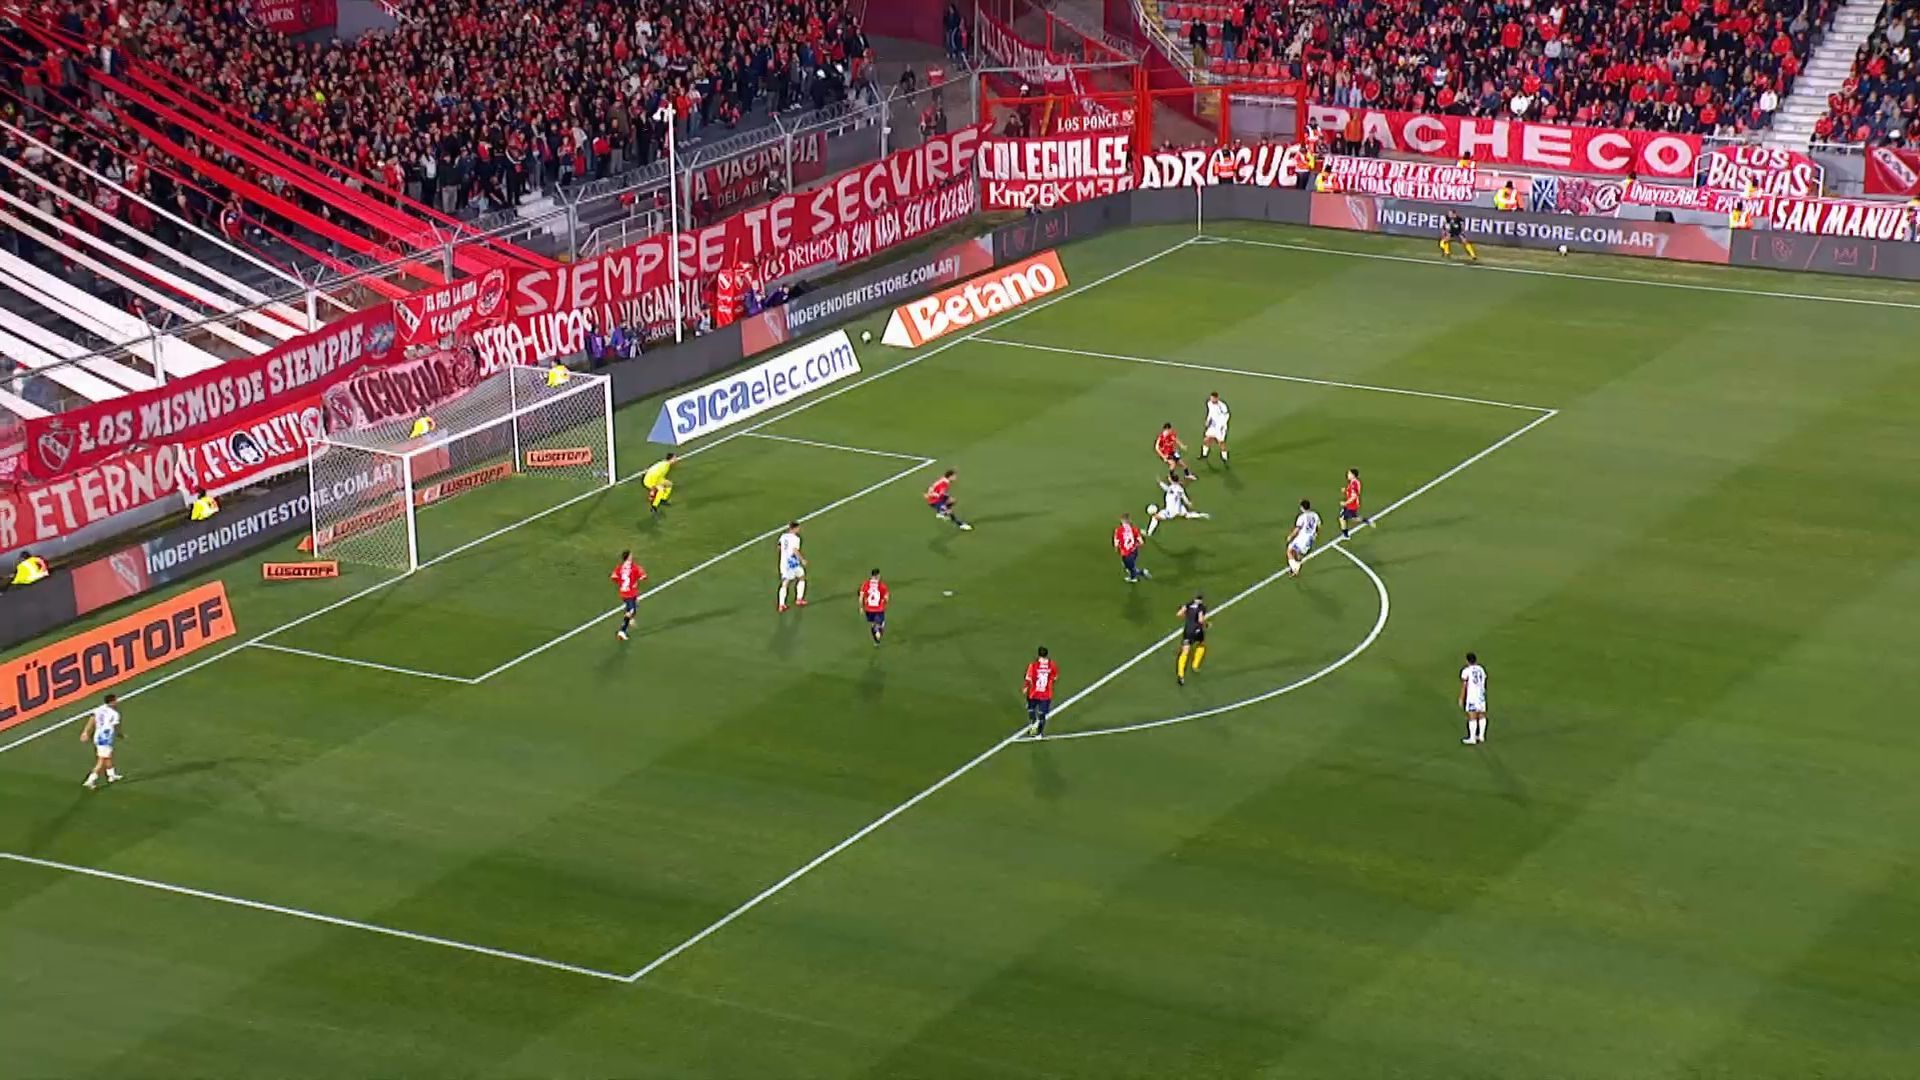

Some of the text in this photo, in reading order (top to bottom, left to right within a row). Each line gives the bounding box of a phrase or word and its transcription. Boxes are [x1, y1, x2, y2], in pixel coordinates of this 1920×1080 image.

[1058, 112, 1119, 133] LOS PONCE
[1308, 105, 1693, 174] PACHECO
[978, 134, 1130, 181] COLEGIALES
[1736, 145, 1790, 169] LOS
[1377, 209, 1654, 247] INDEPENIENTESTORE.COM.AR
[1772, 199, 1822, 235] SAN
[516, 222, 726, 318] SIEMPRE
[744, 197, 796, 256] TE
[787, 233, 835, 273] PRIMOS
[911, 262, 1056, 343] Betano
[78, 322, 366, 454] LOS MISMOS DE SIEMPRE
[677, 339, 854, 435] sicaelec.com
[28, 444, 176, 542] ETERNO
